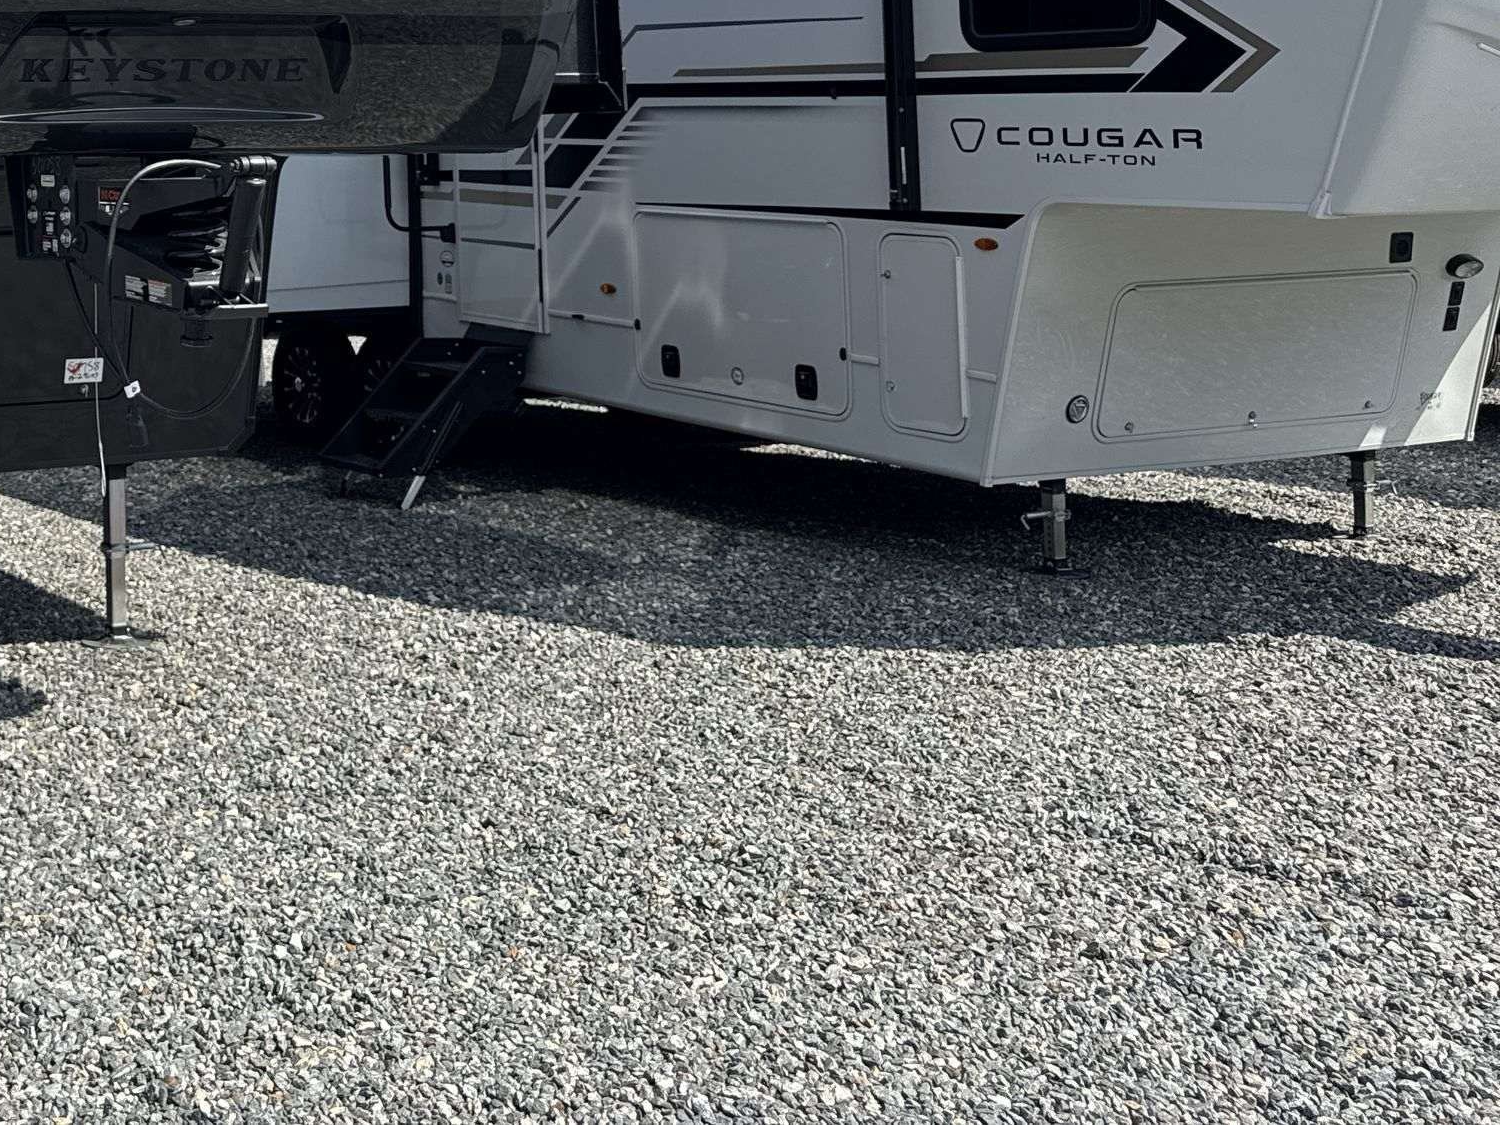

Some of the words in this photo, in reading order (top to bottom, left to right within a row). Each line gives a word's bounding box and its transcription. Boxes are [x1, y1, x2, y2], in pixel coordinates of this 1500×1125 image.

[18, 58, 309, 83] KEYSTONE
[997, 126, 1203, 150] COUGAR
[1036, 152, 1156, 166] HALF-TON
